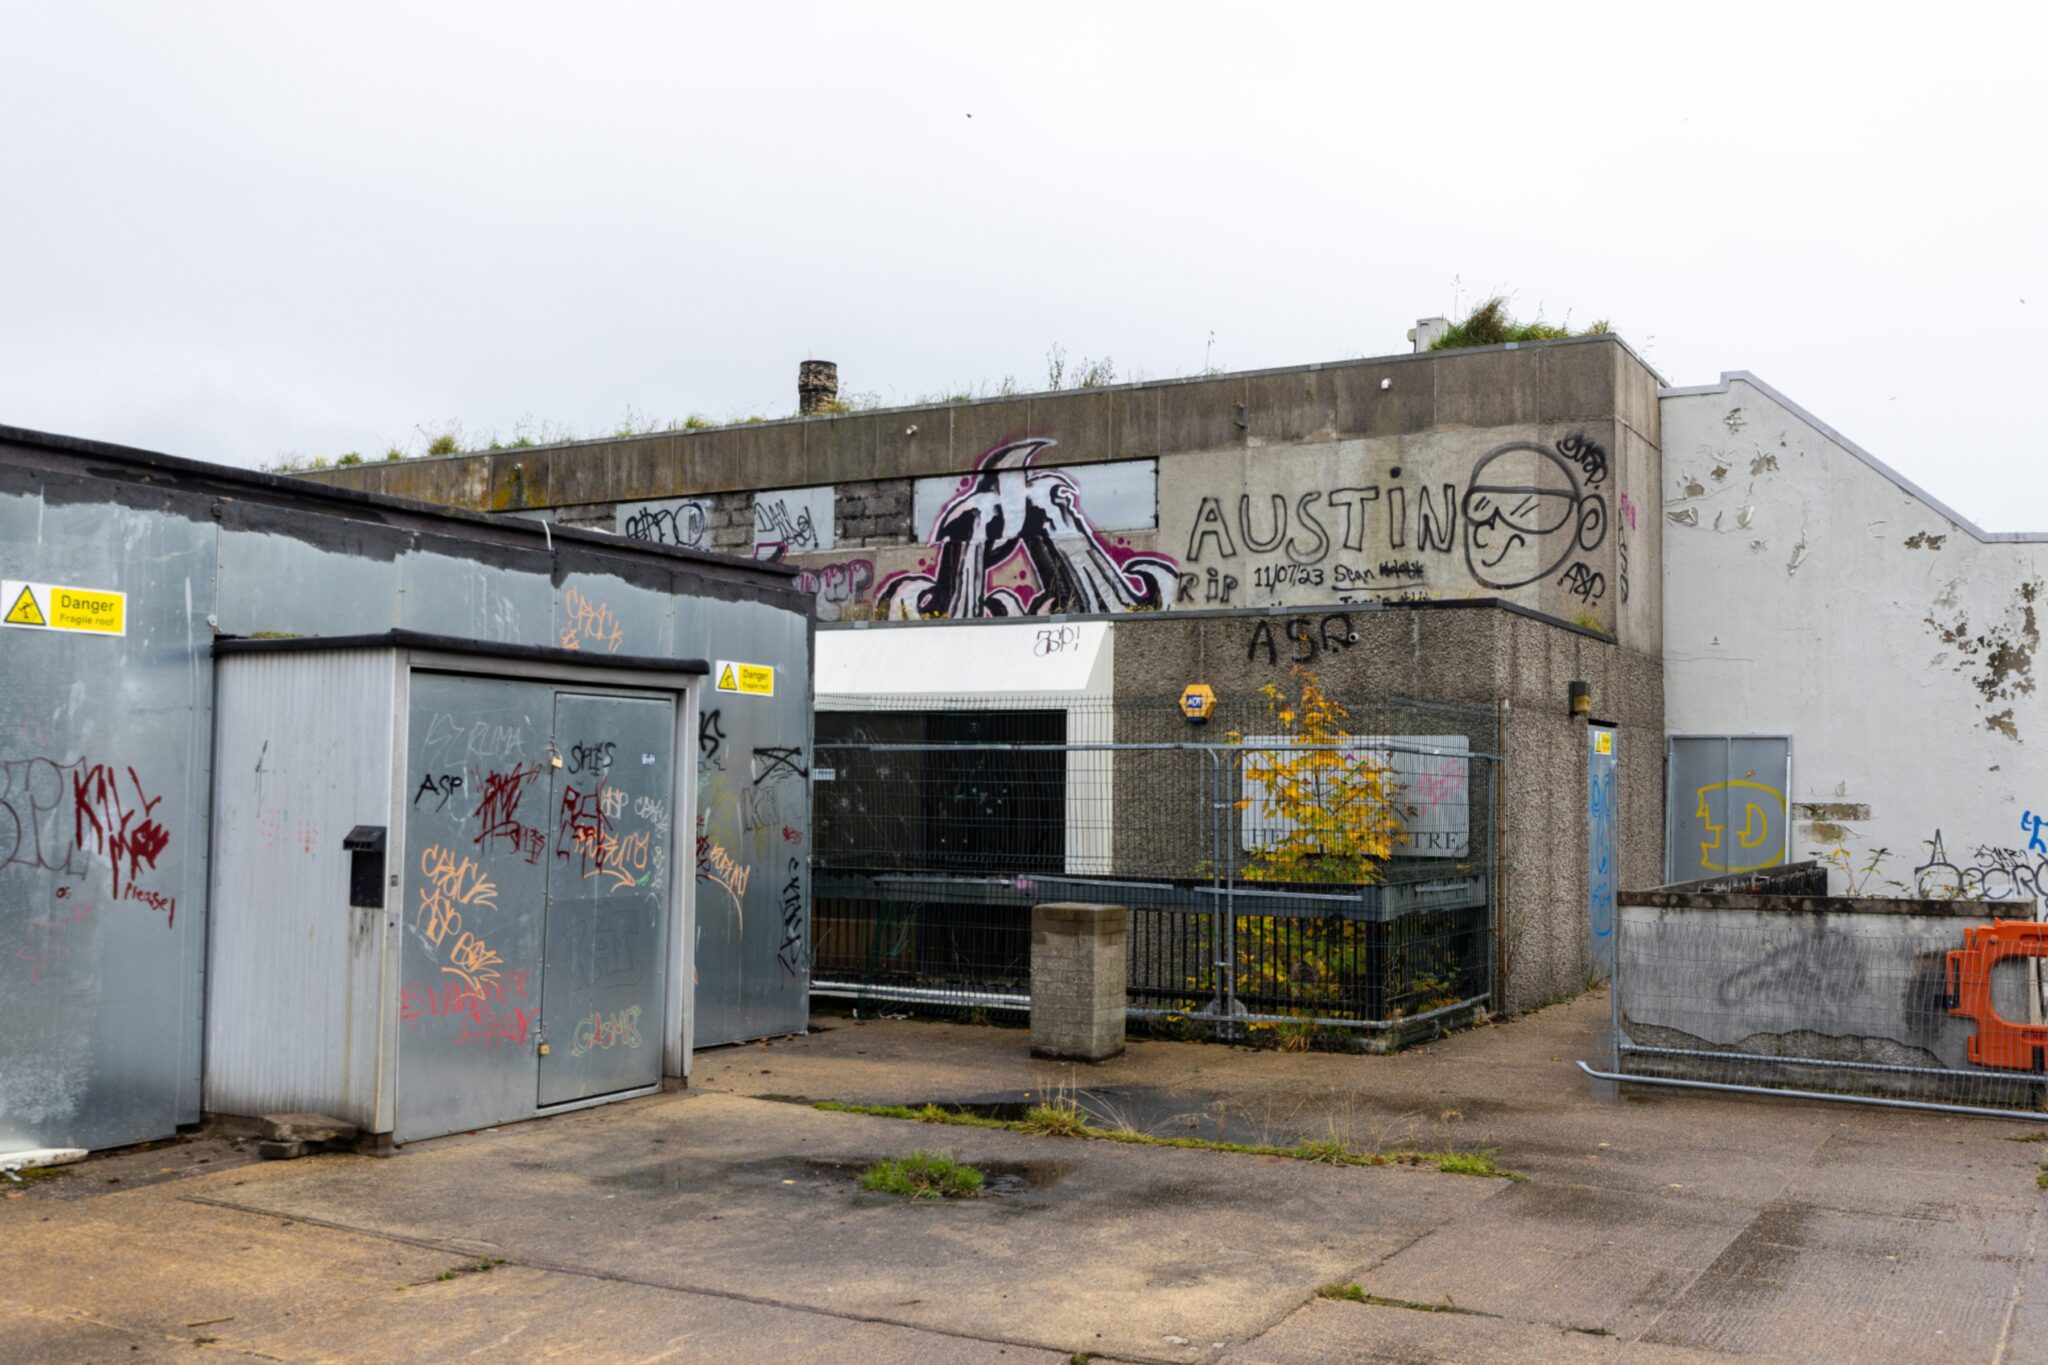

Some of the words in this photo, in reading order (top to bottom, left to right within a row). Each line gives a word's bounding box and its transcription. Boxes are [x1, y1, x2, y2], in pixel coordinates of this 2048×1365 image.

[1254, 563, 1324, 594] 11/07/23
[61, 594, 115, 614] Danger
[60, 613, 92, 626] Fragile
[95, 617, 115, 626] roof
[743, 669, 769, 681] Danger
[414, 774, 463, 812] ASP
